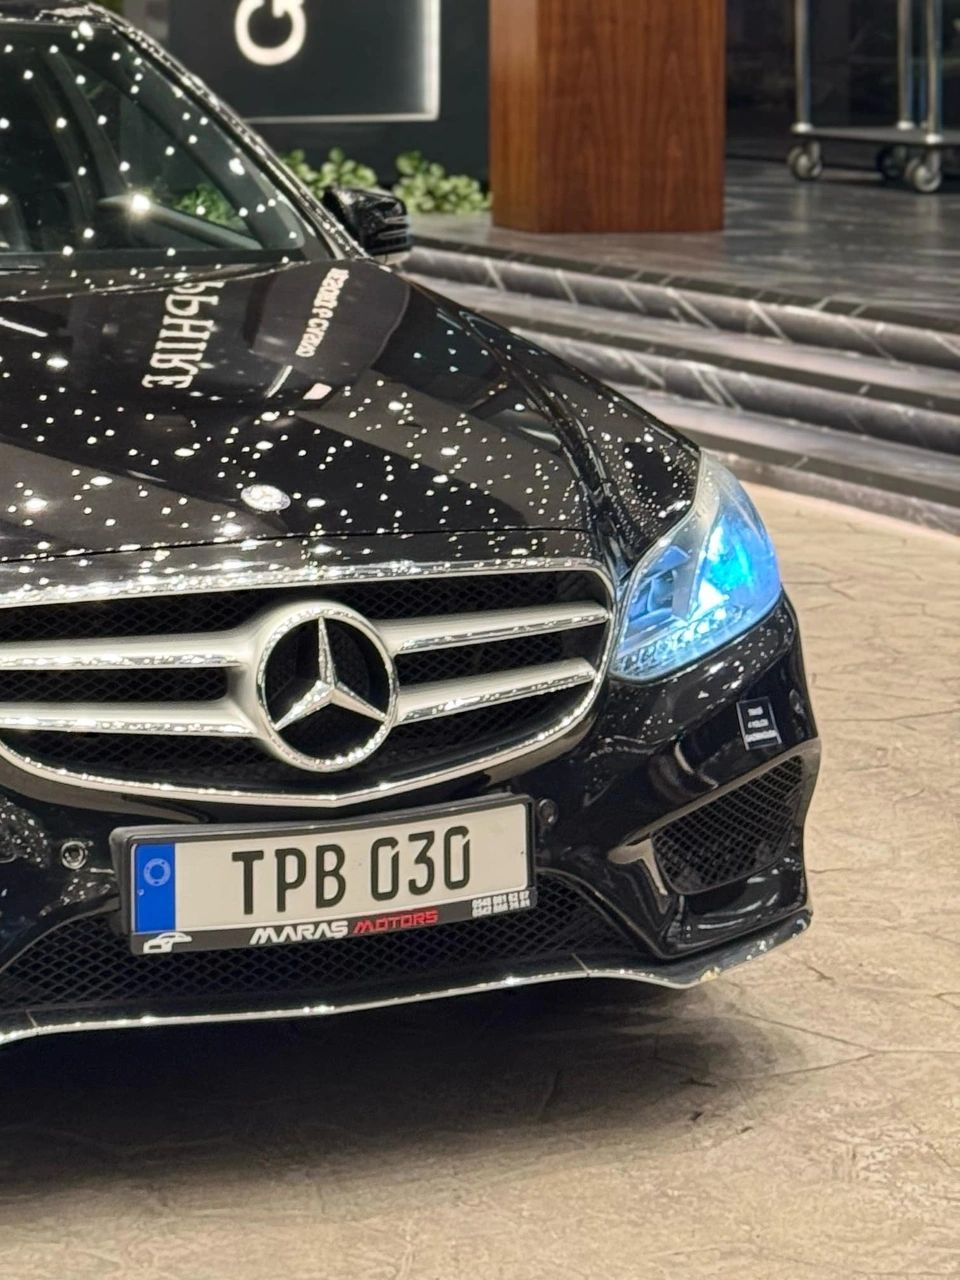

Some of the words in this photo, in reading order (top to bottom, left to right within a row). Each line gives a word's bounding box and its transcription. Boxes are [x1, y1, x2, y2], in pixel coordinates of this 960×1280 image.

[232, 844, 346, 915] TPB
[370, 826, 471, 902] 030
[353, 910, 438, 934] MOTORS
